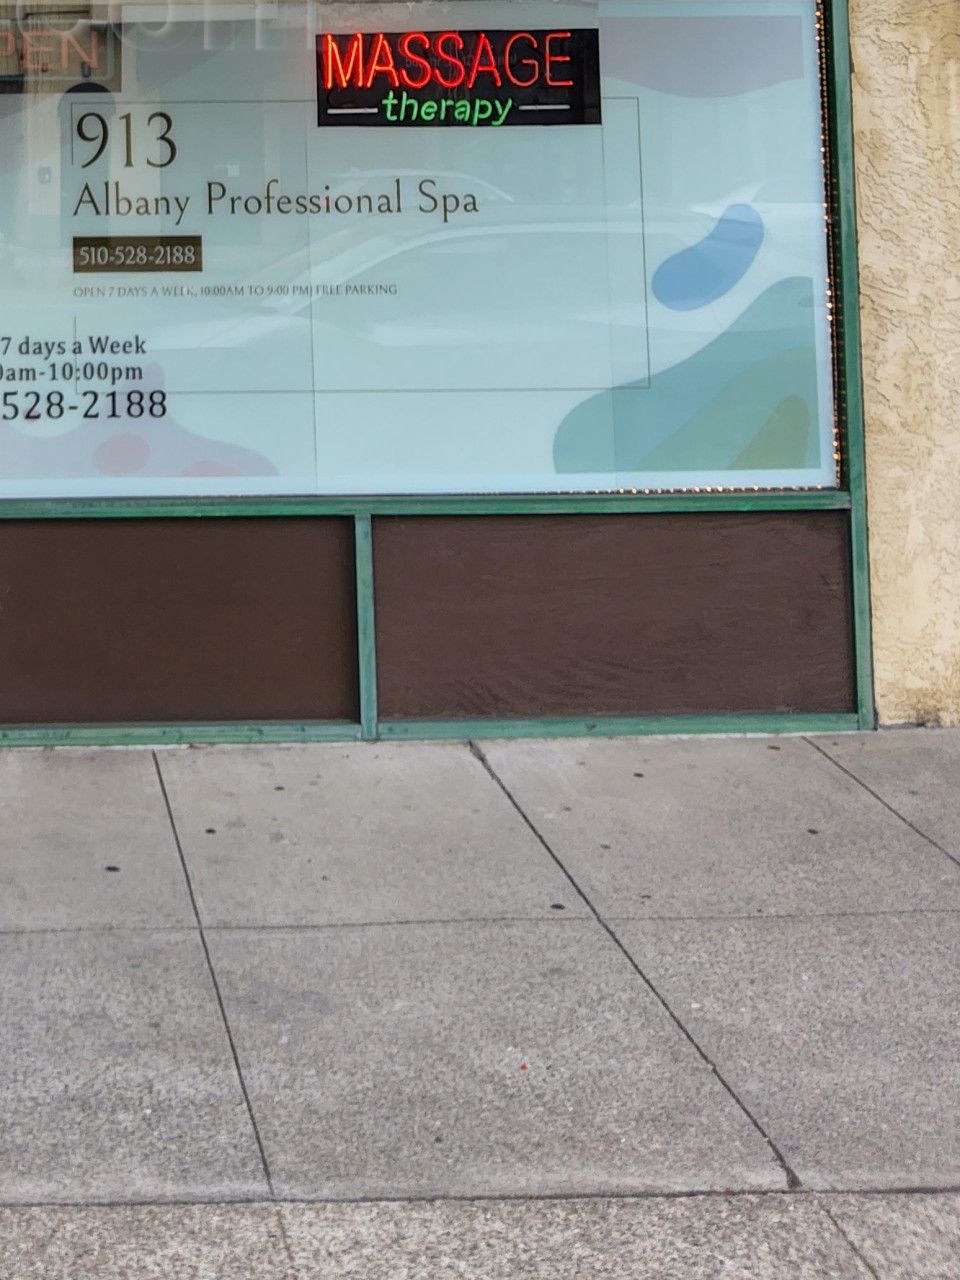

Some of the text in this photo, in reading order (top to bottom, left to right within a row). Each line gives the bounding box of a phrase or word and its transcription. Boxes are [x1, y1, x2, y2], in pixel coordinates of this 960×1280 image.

[322, 32, 574, 89] MASSAGE
[381, 89, 513, 127] therapy
[76, 111, 178, 169] 913
[73, 178, 479, 225] Albany Professional Spa
[78, 245, 197, 266] 510-528-2188
[344, 284, 398, 296] PARKING
[0, 337, 12, 356] 7
[18, 336, 66, 361] days
[72, 341, 83, 355] a
[89, 335, 147, 355] Week
